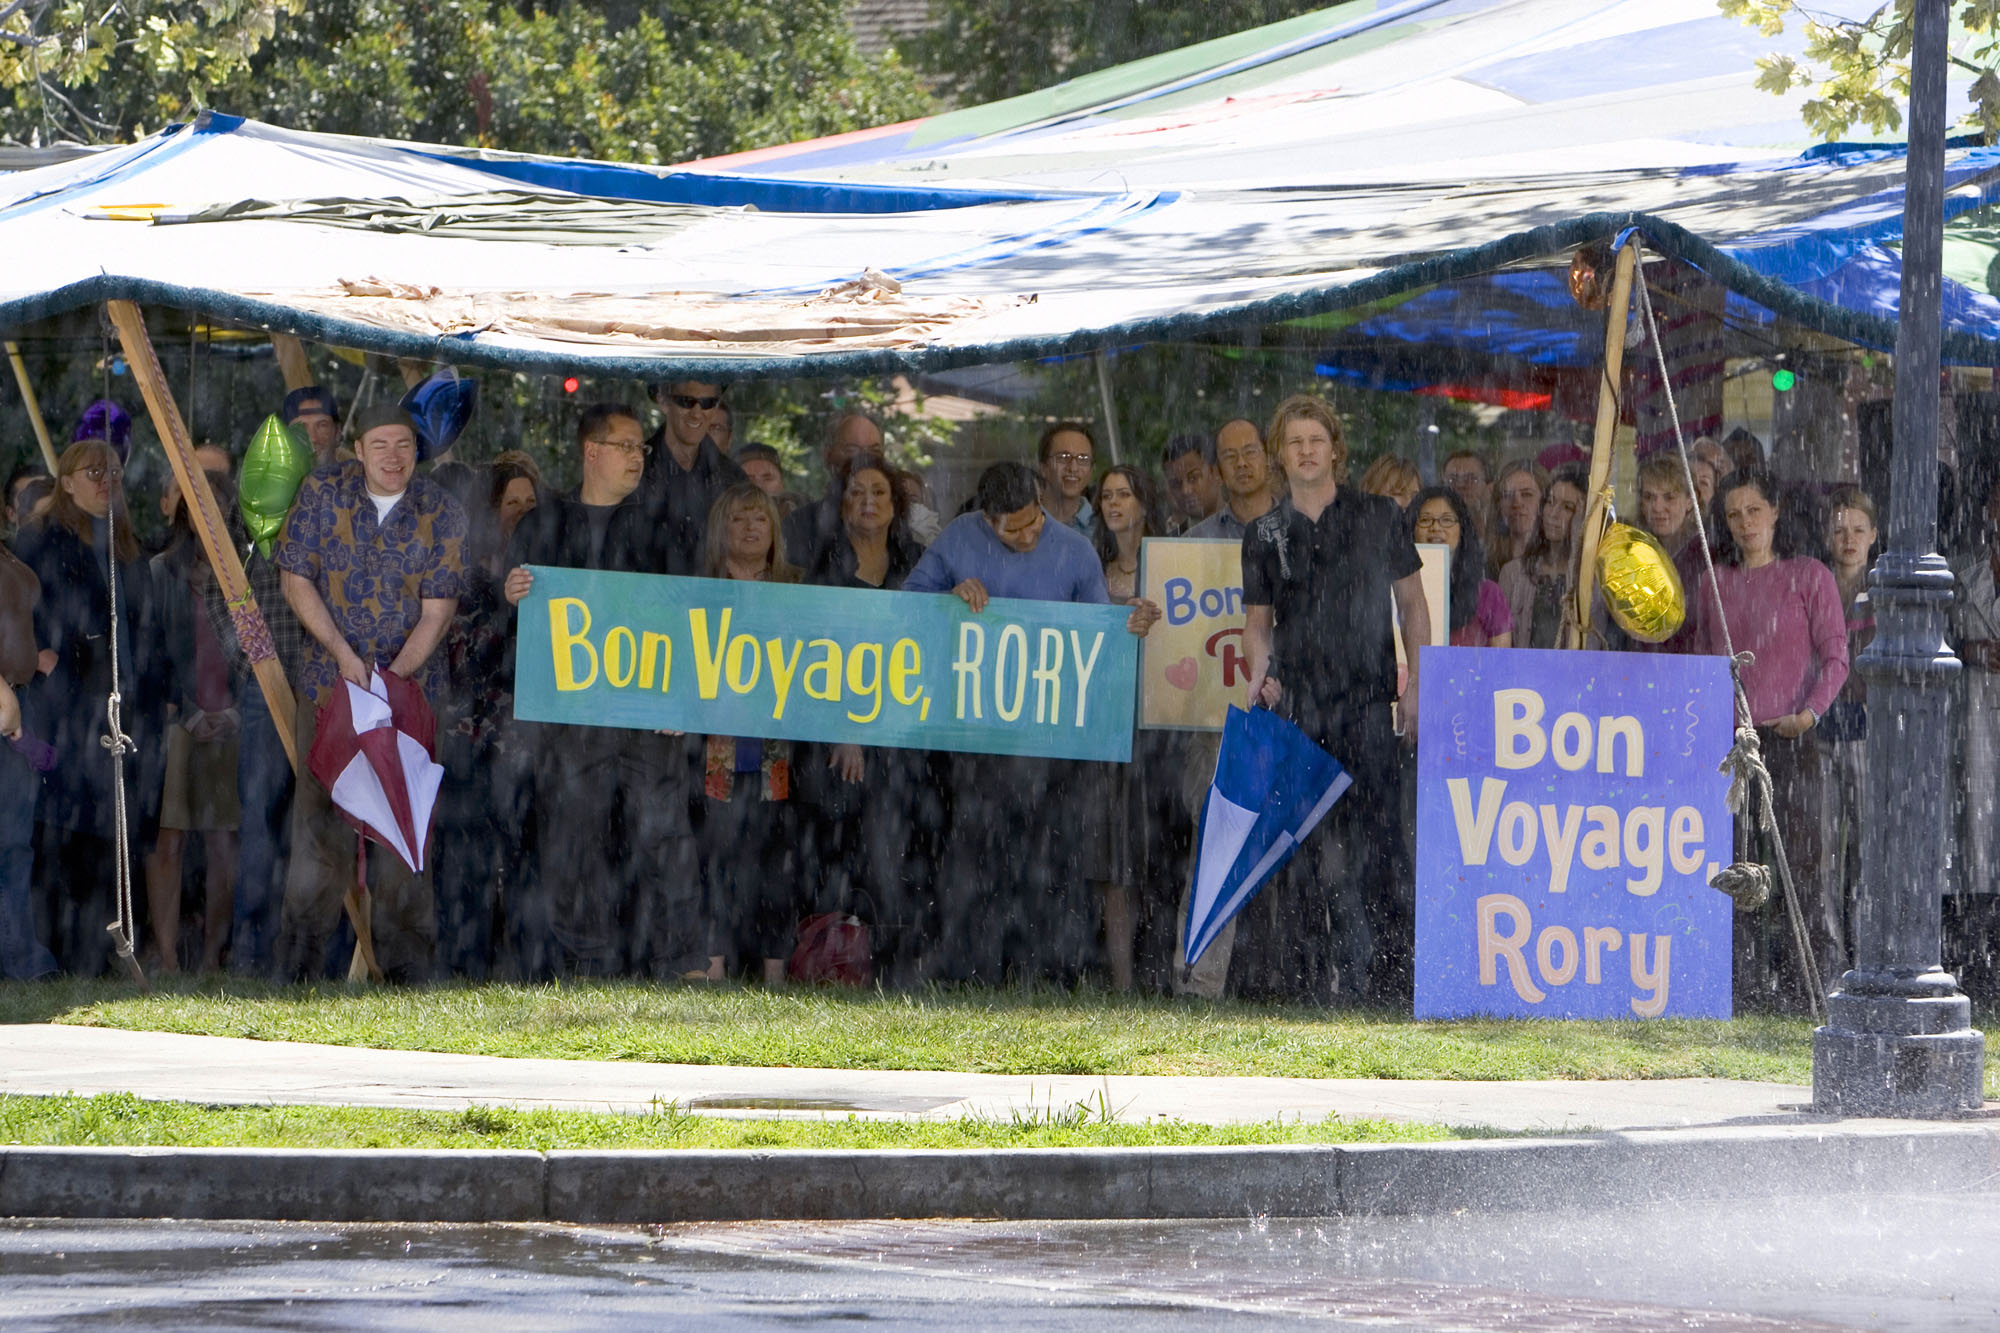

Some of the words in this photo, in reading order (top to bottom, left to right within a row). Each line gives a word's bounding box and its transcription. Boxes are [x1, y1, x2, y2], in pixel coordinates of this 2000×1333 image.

[1164, 577, 1247, 626] Bon
[548, 597, 673, 694] Bon
[688, 607, 931, 724] Voyage,
[952, 621, 1105, 728] RORY
[1493, 688, 1645, 778] Bon
[1446, 777, 1720, 897] Voyage,
[1476, 893, 1673, 1018] Rory
